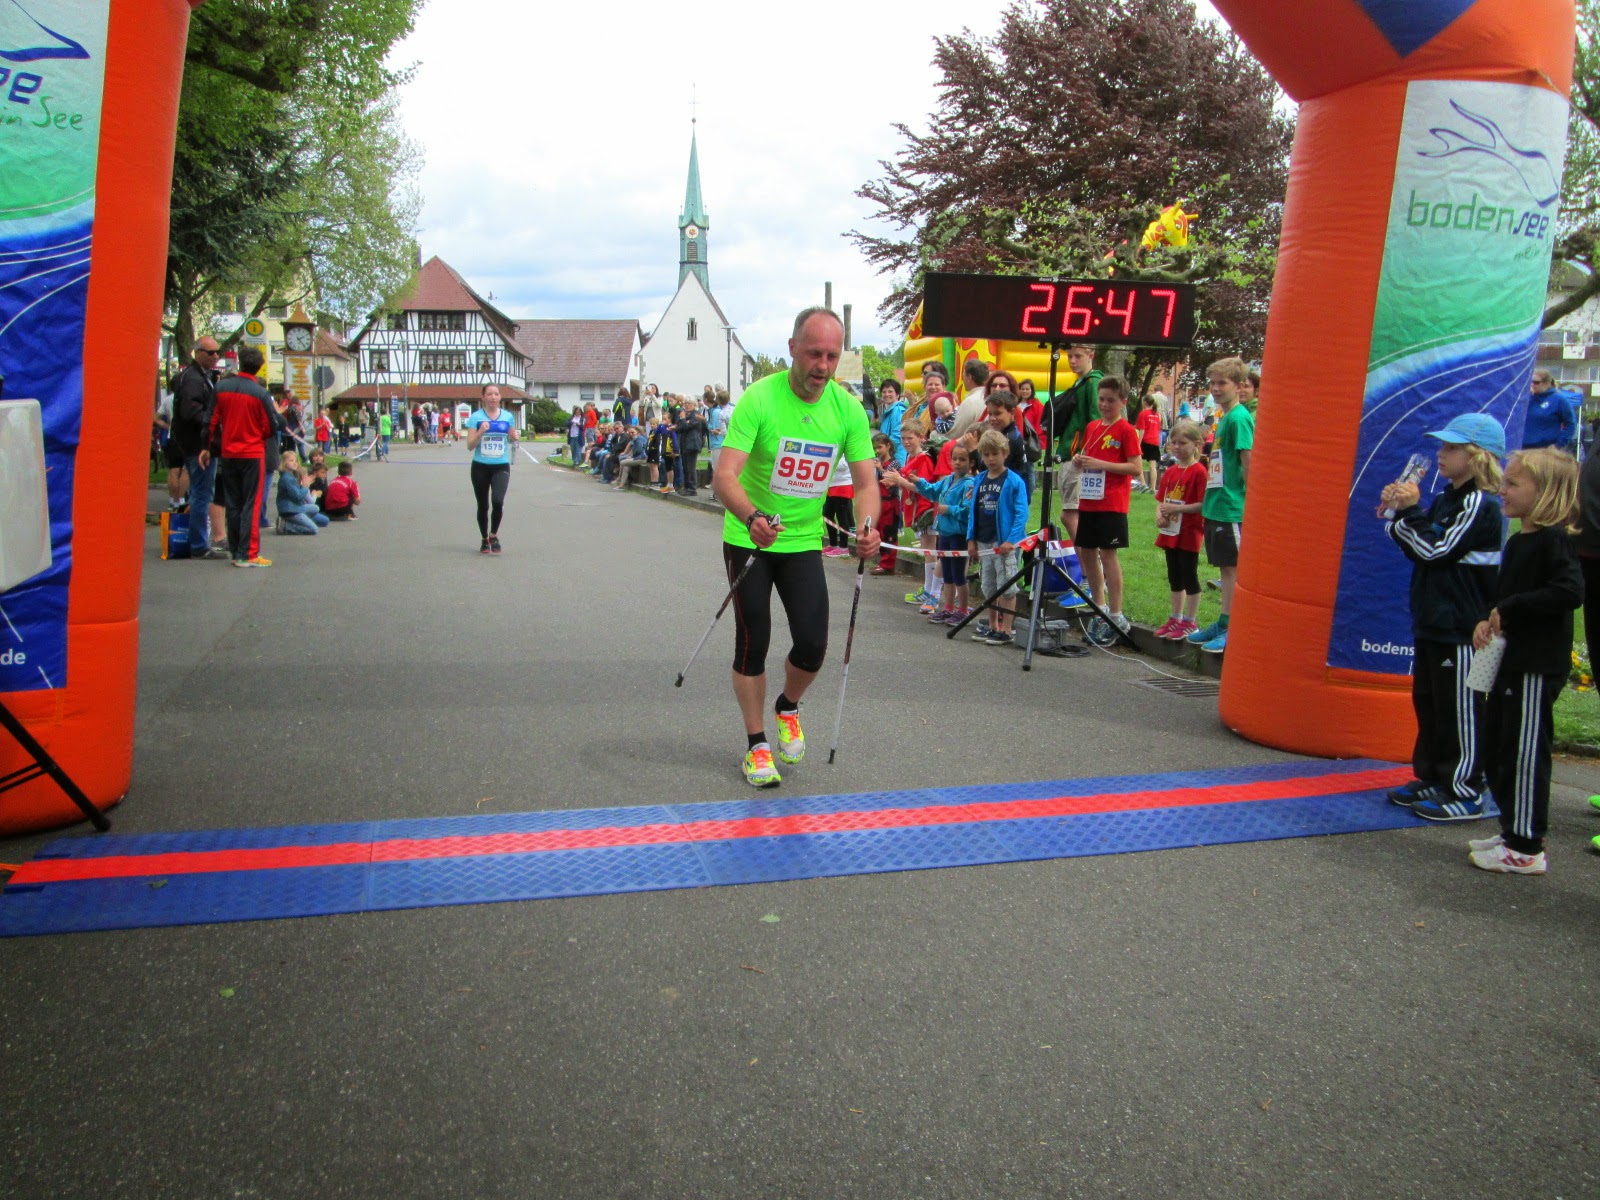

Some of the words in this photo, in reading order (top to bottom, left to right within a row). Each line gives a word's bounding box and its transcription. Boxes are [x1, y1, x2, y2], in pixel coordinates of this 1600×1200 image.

[32, 96, 83, 131] See
[1407, 189, 1549, 239] bodensee
[1022, 284, 1176, 338] 26:47
[483, 443, 503, 451] 1579
[777, 456, 830, 482] 950
[787, 480, 814, 489] RAINER
[0, 648, 26, 665] de
[1361, 639, 1415, 656] bodens
